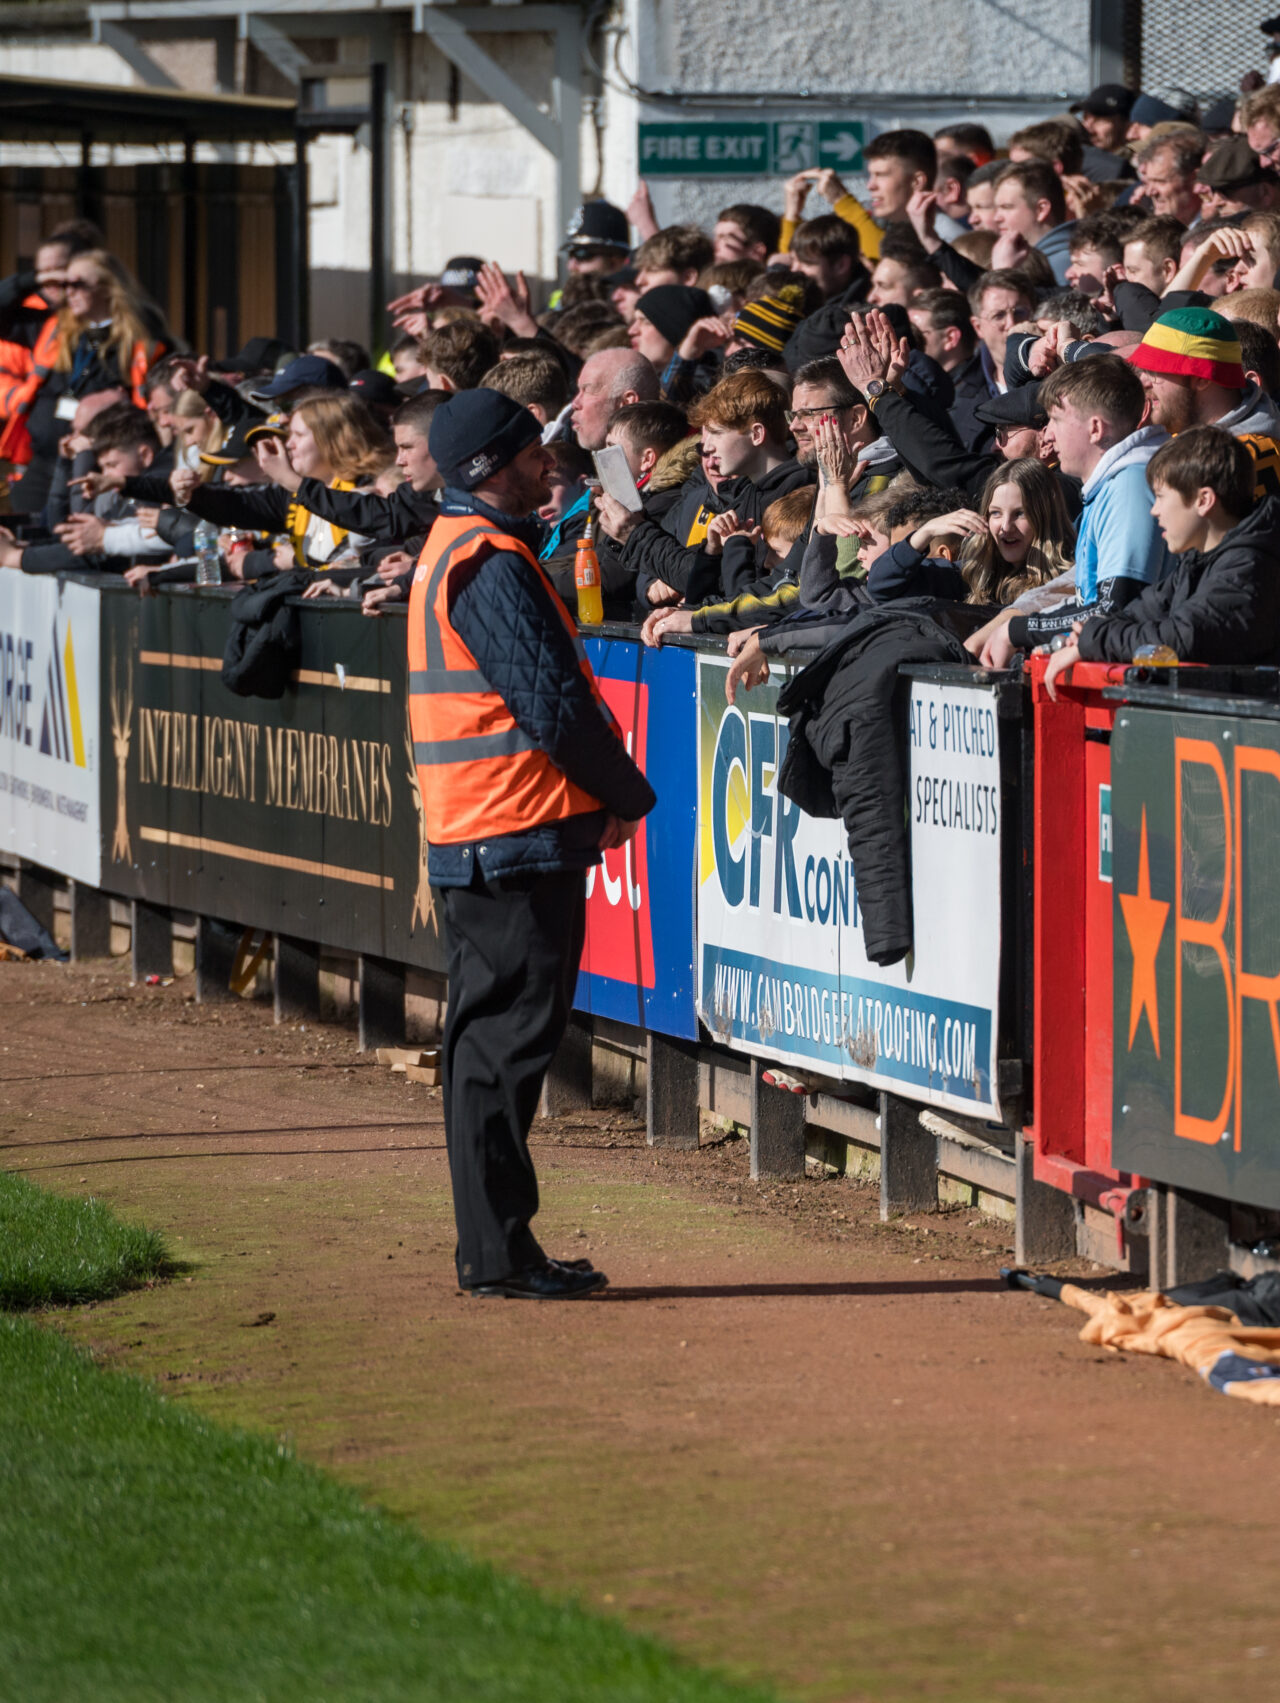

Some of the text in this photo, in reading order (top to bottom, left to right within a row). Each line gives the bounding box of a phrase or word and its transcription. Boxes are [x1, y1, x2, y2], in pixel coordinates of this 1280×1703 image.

[643, 135, 765, 160] FIRE EXIT
[944, 702, 995, 758] PITCHED
[139, 707, 259, 804] INTELLIGENT
[265, 726, 392, 828] MEMBRANES
[711, 706, 804, 924] CFR
[916, 775, 997, 836] SPECIALISTS
